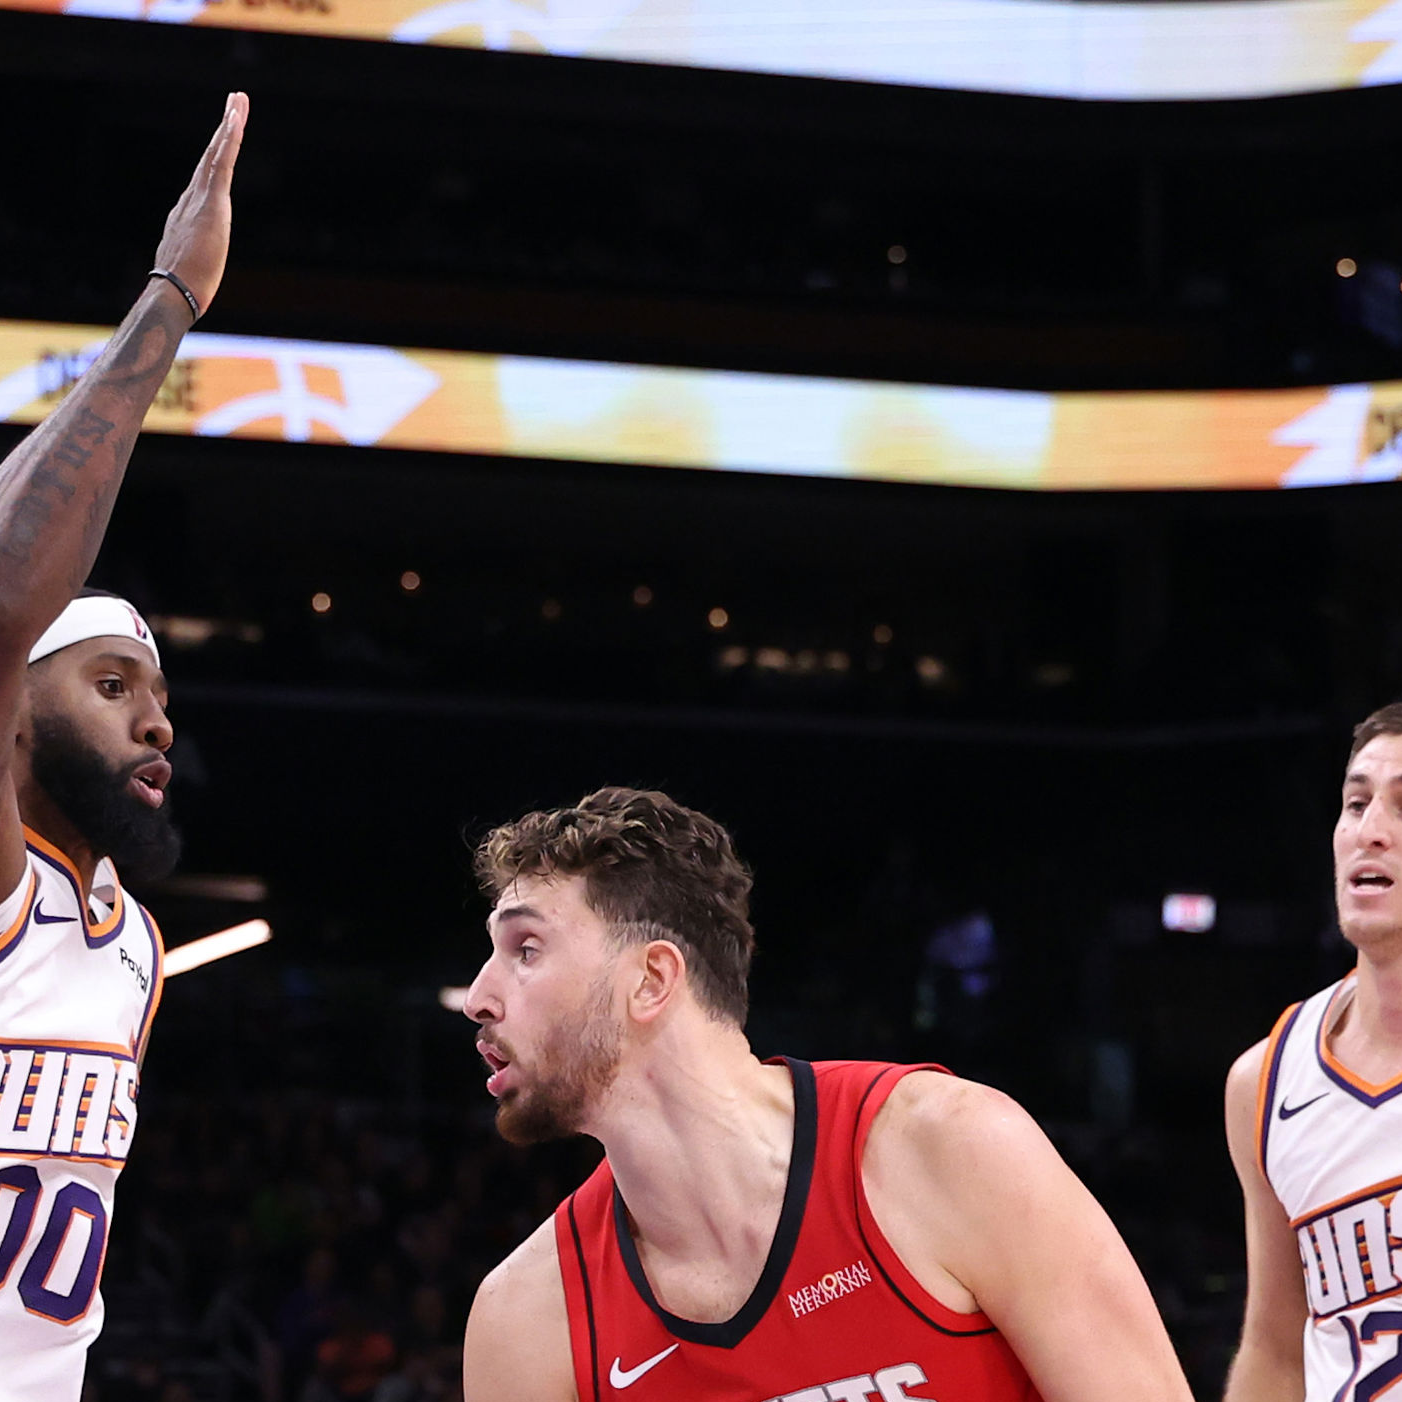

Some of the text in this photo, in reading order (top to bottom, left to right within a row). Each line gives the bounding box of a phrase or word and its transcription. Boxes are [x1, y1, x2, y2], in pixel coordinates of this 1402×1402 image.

[119, 947, 149, 994] PayPal
[788, 1260, 869, 1306] MEMORIAL
[791, 1268, 873, 1319] HERMANN
